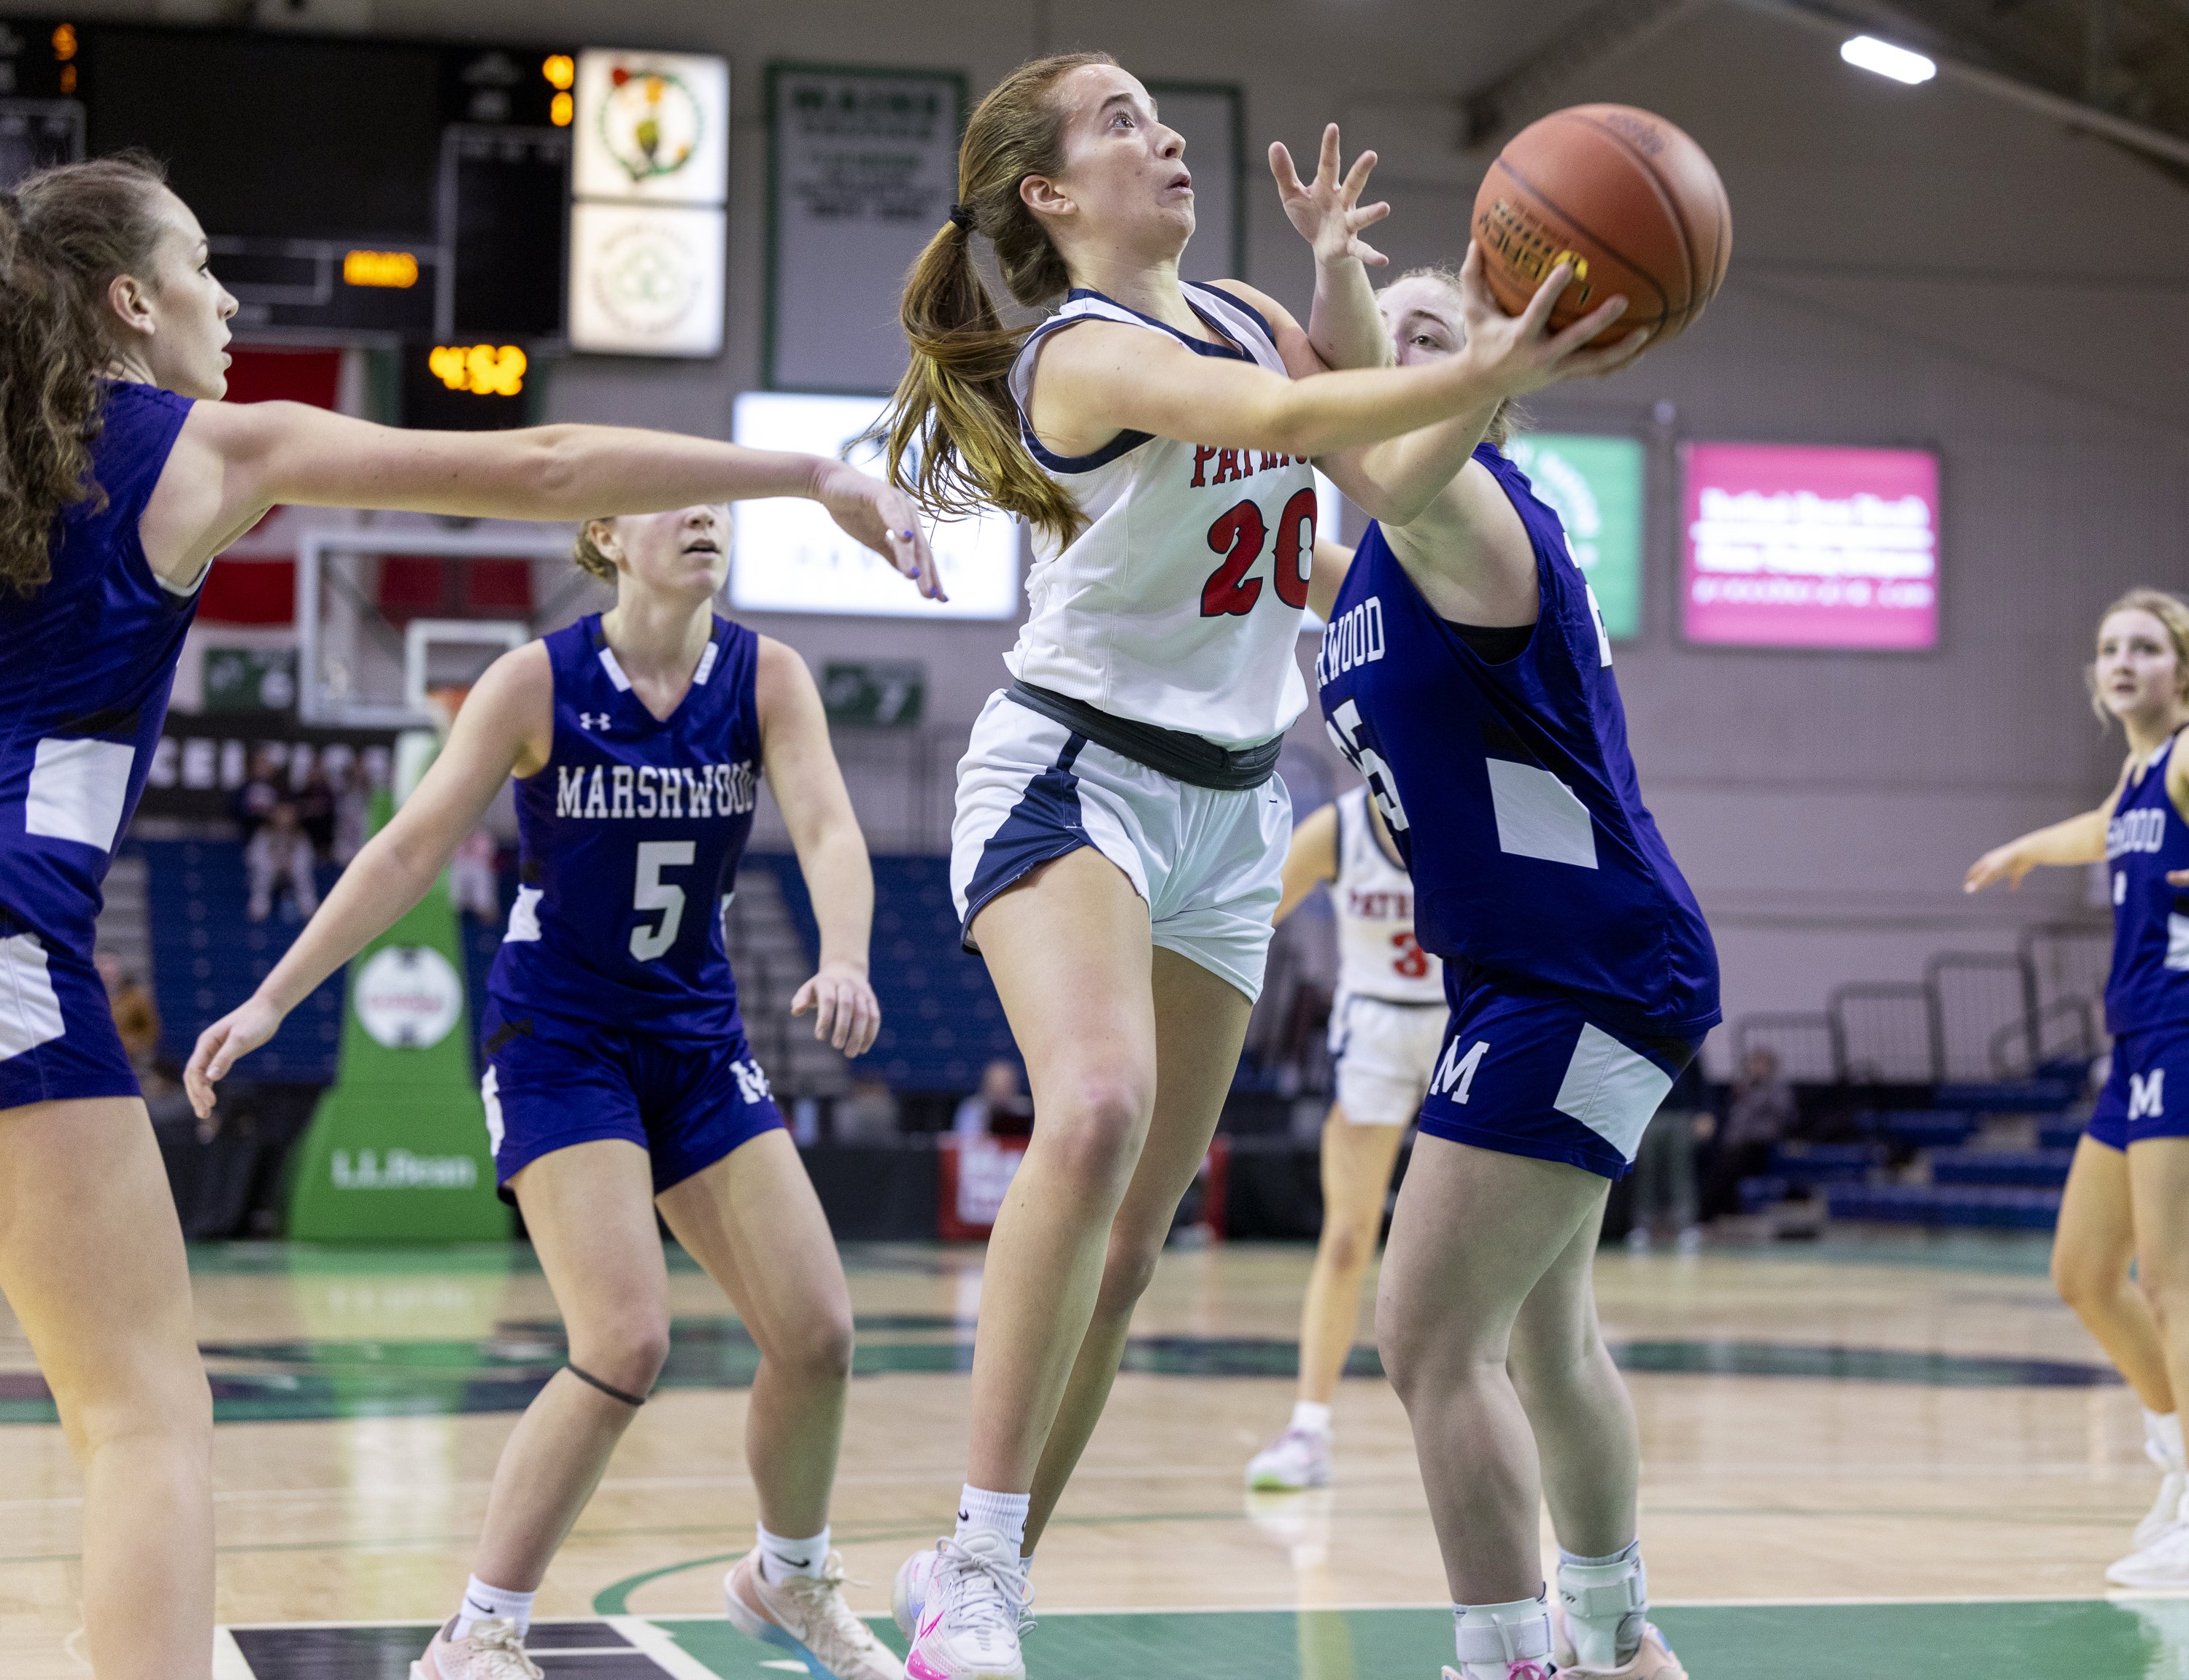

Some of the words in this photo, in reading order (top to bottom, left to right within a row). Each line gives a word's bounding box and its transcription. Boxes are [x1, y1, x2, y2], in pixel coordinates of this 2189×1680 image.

[1200, 487, 1317, 617] 20
[629, 840, 696, 962] 5
[1391, 928, 1429, 979] 3
[1429, 1034, 1490, 1104] M
[2128, 1068, 2166, 1121] M
